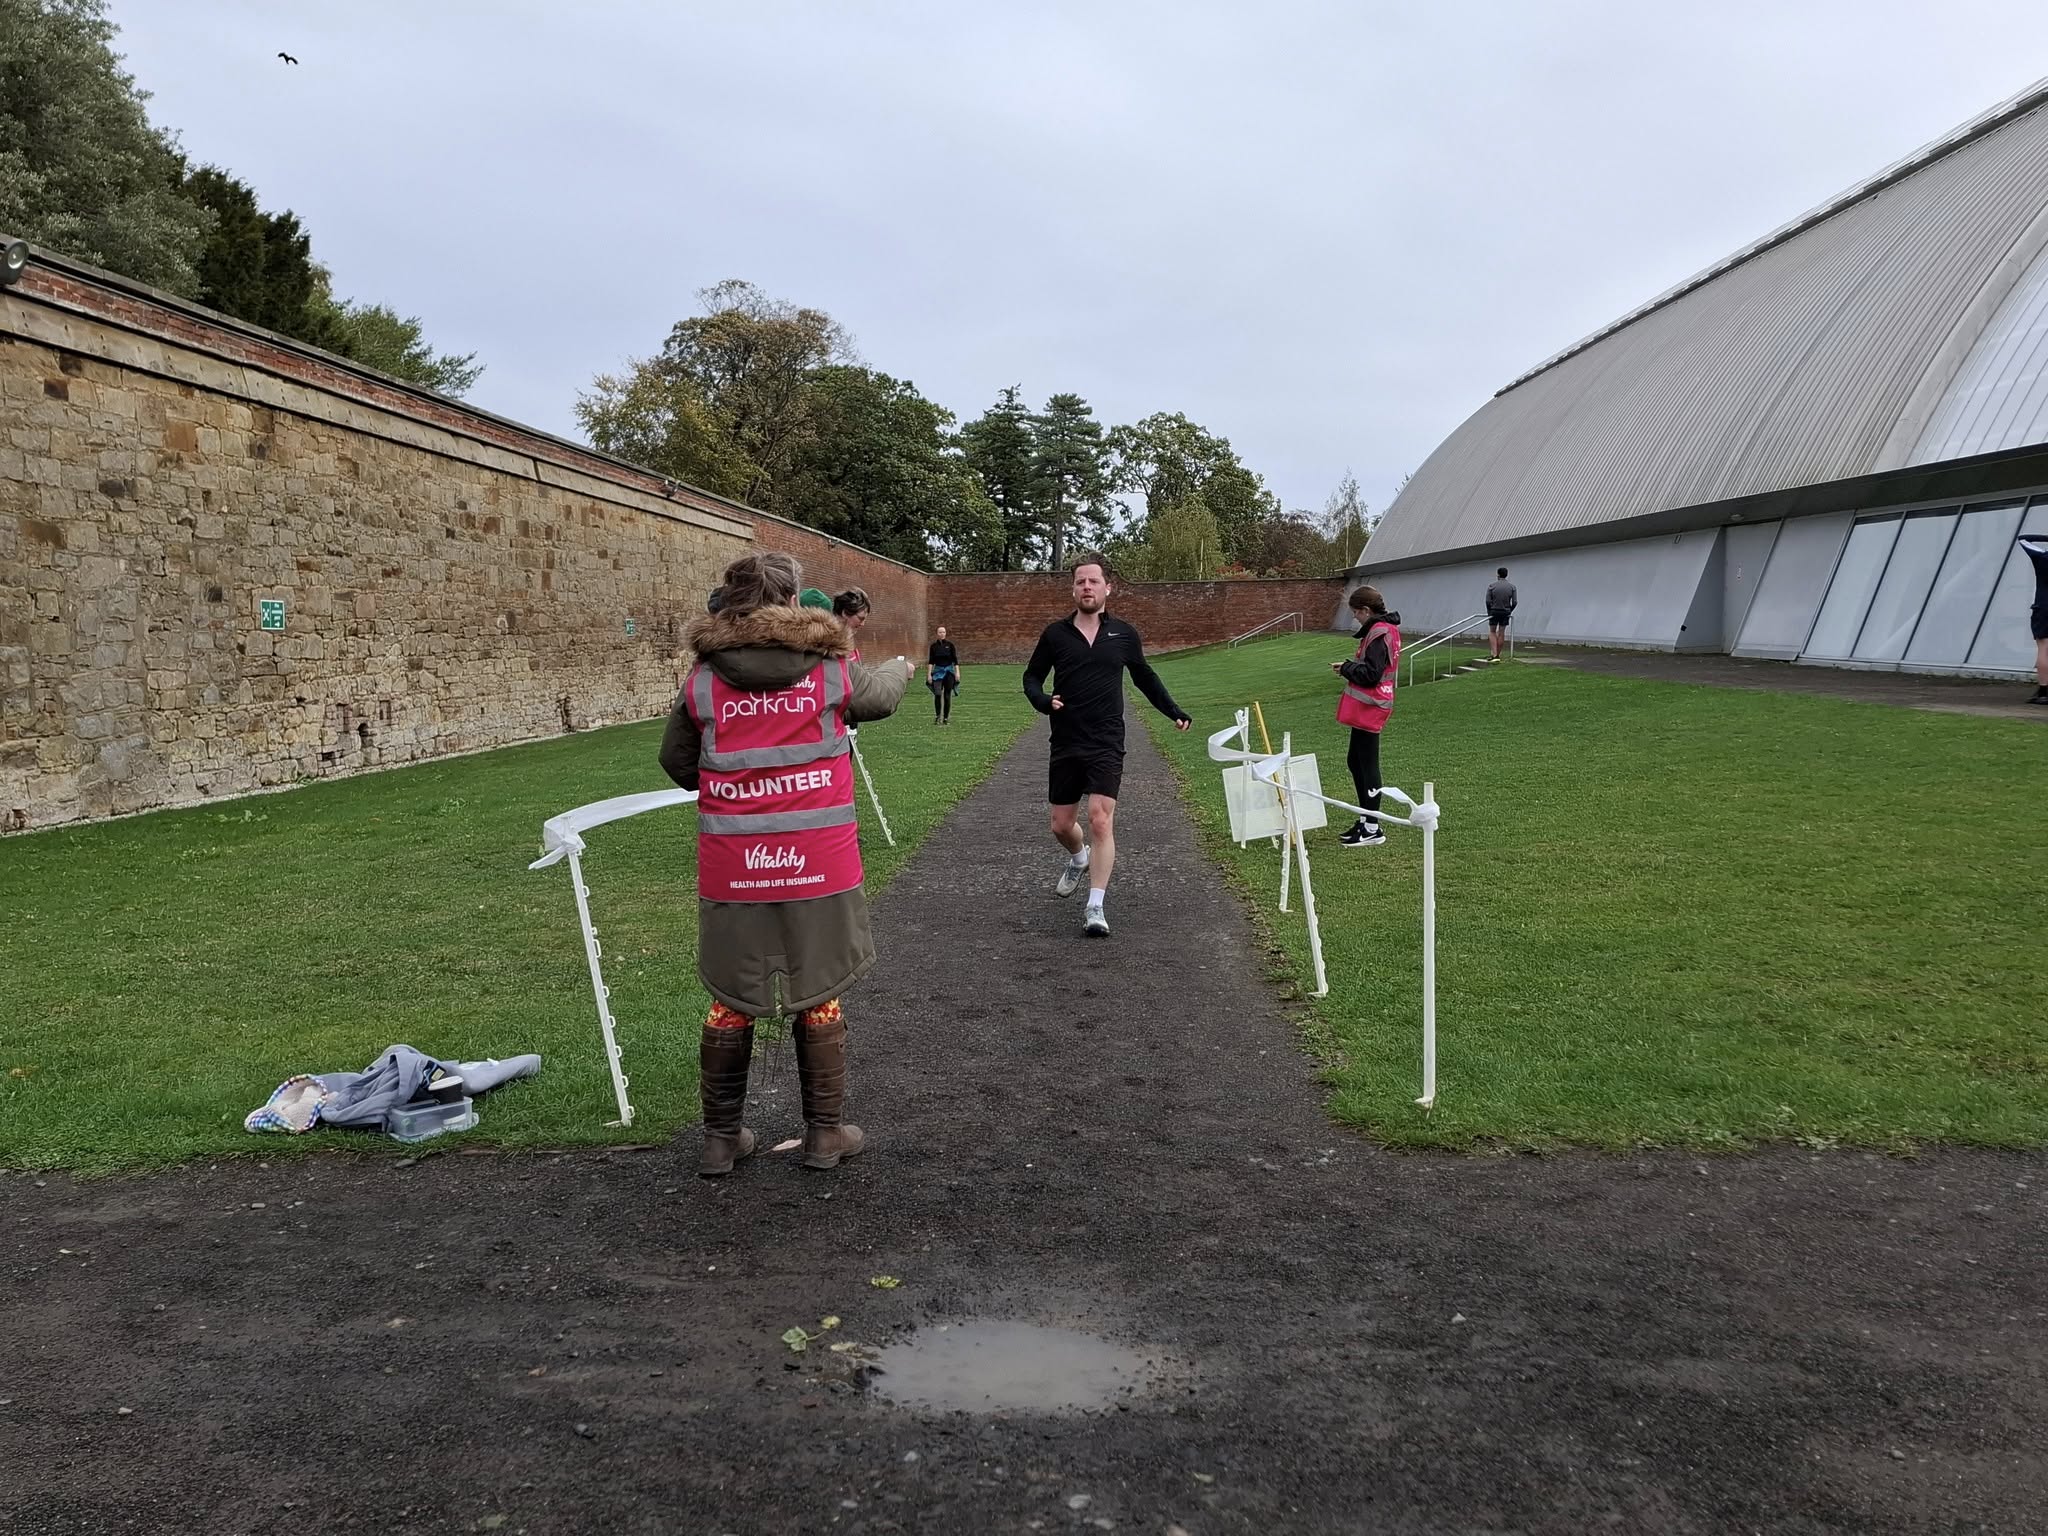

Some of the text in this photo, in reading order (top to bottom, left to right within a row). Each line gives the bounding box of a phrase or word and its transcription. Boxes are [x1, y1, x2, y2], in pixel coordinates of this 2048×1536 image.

[722, 690, 816, 723] parkrun
[709, 769, 833, 800] VOLUNTEER
[745, 843, 805, 874] Vitality
[730, 874, 825, 889] HEALTH AND LIFE INSURANCE
